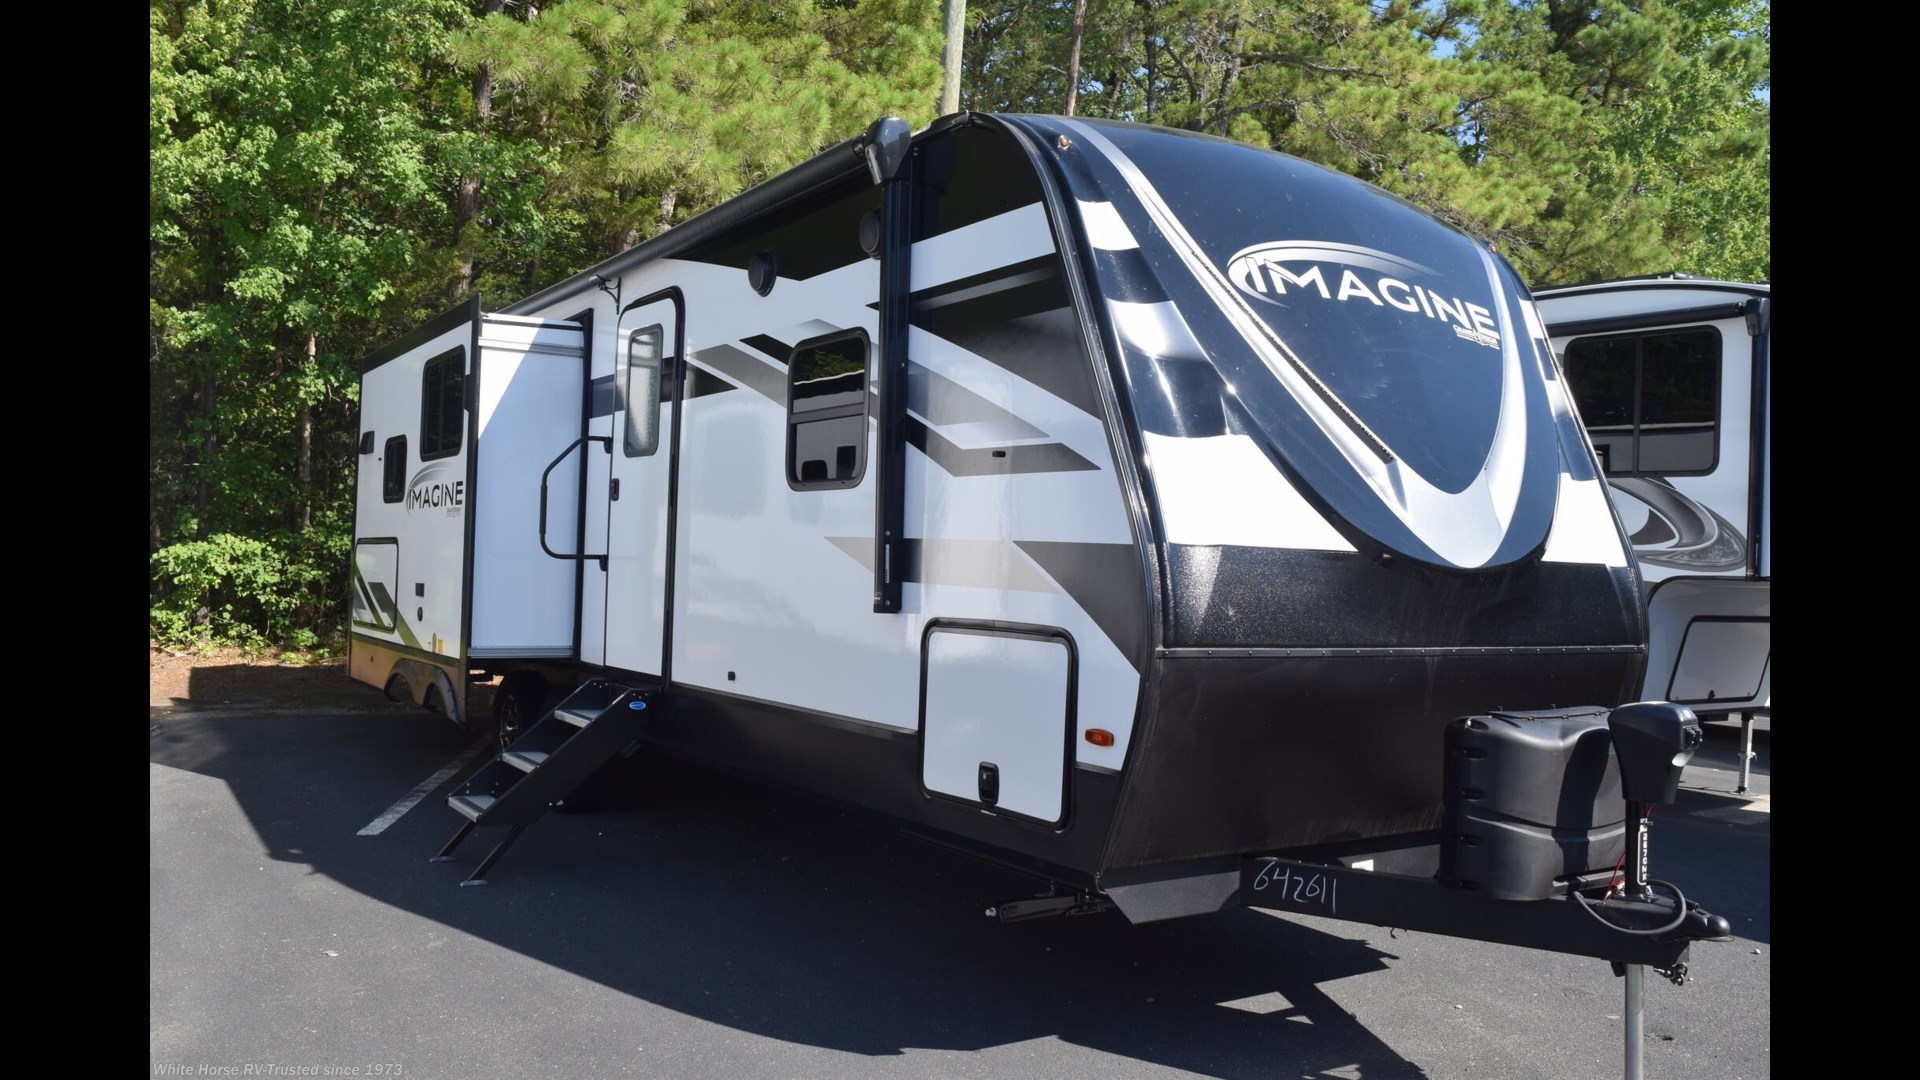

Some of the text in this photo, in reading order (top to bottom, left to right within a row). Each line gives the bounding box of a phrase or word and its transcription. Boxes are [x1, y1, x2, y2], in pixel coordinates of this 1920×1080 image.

[1245, 256, 1500, 339] IMAGINE
[408, 480, 464, 510] IMAGINE
[1253, 861, 1337, 914] 642611
